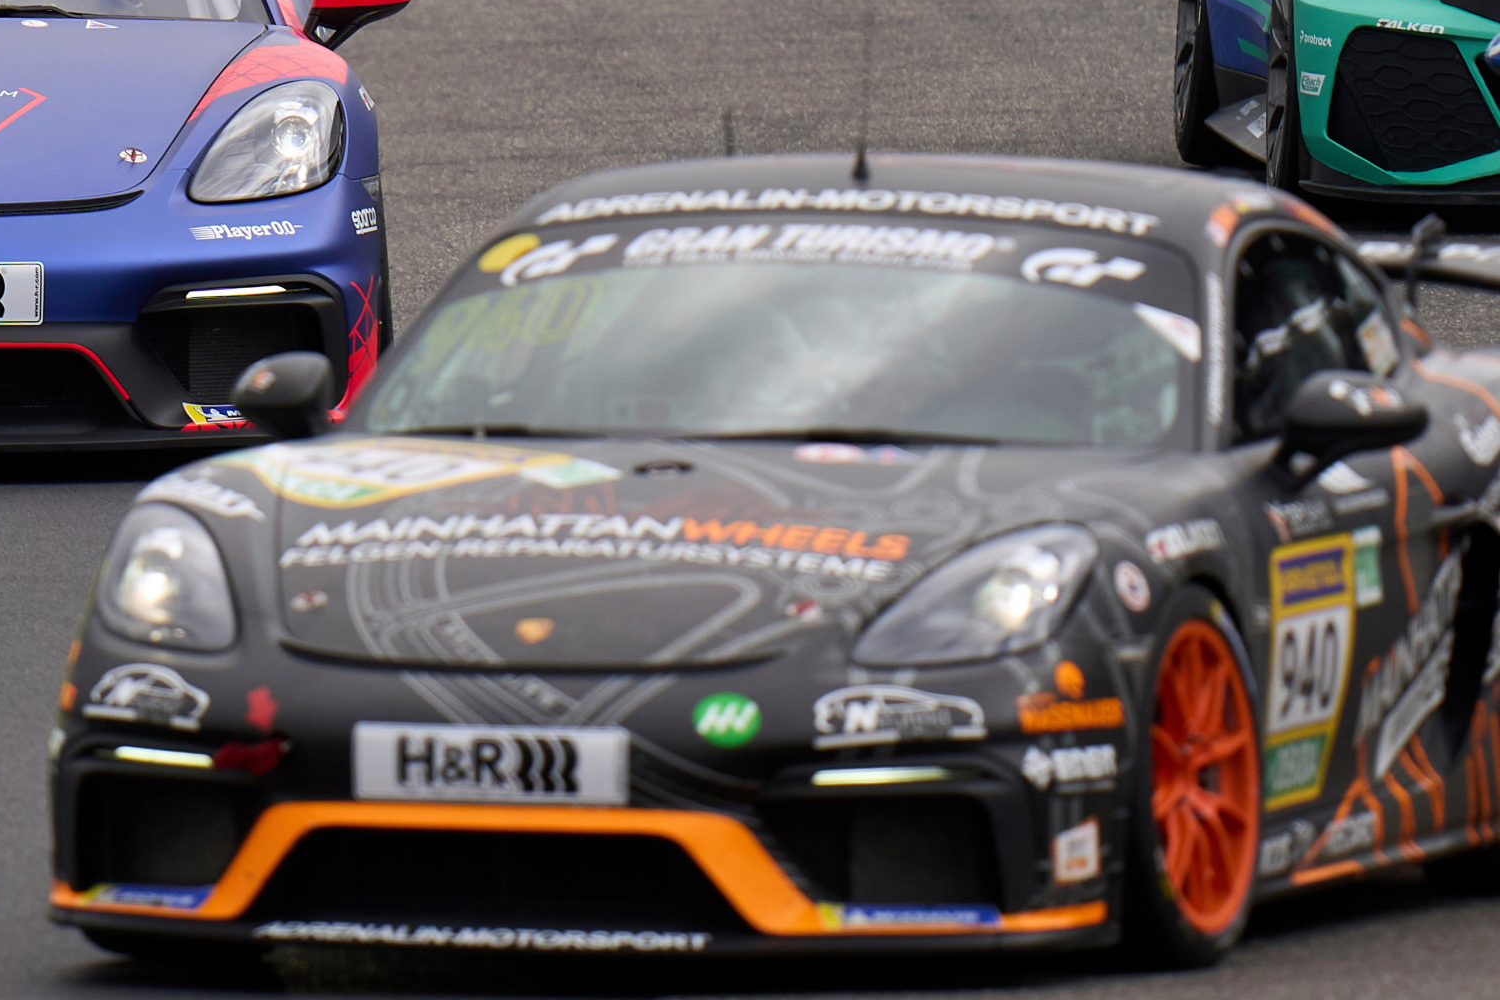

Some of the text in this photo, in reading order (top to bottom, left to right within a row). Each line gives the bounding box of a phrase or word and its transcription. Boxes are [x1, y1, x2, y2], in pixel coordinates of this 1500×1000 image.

[1376, 18, 1445, 35] FALKEN
[351, 207, 377, 229] sparco
[538, 189, 1161, 239] ADRENALIN-MOTORSPORT
[623, 225, 997, 263] GRAN TURISMO
[1280, 618, 1341, 719] 940
[396, 735, 506, 790] H&R
